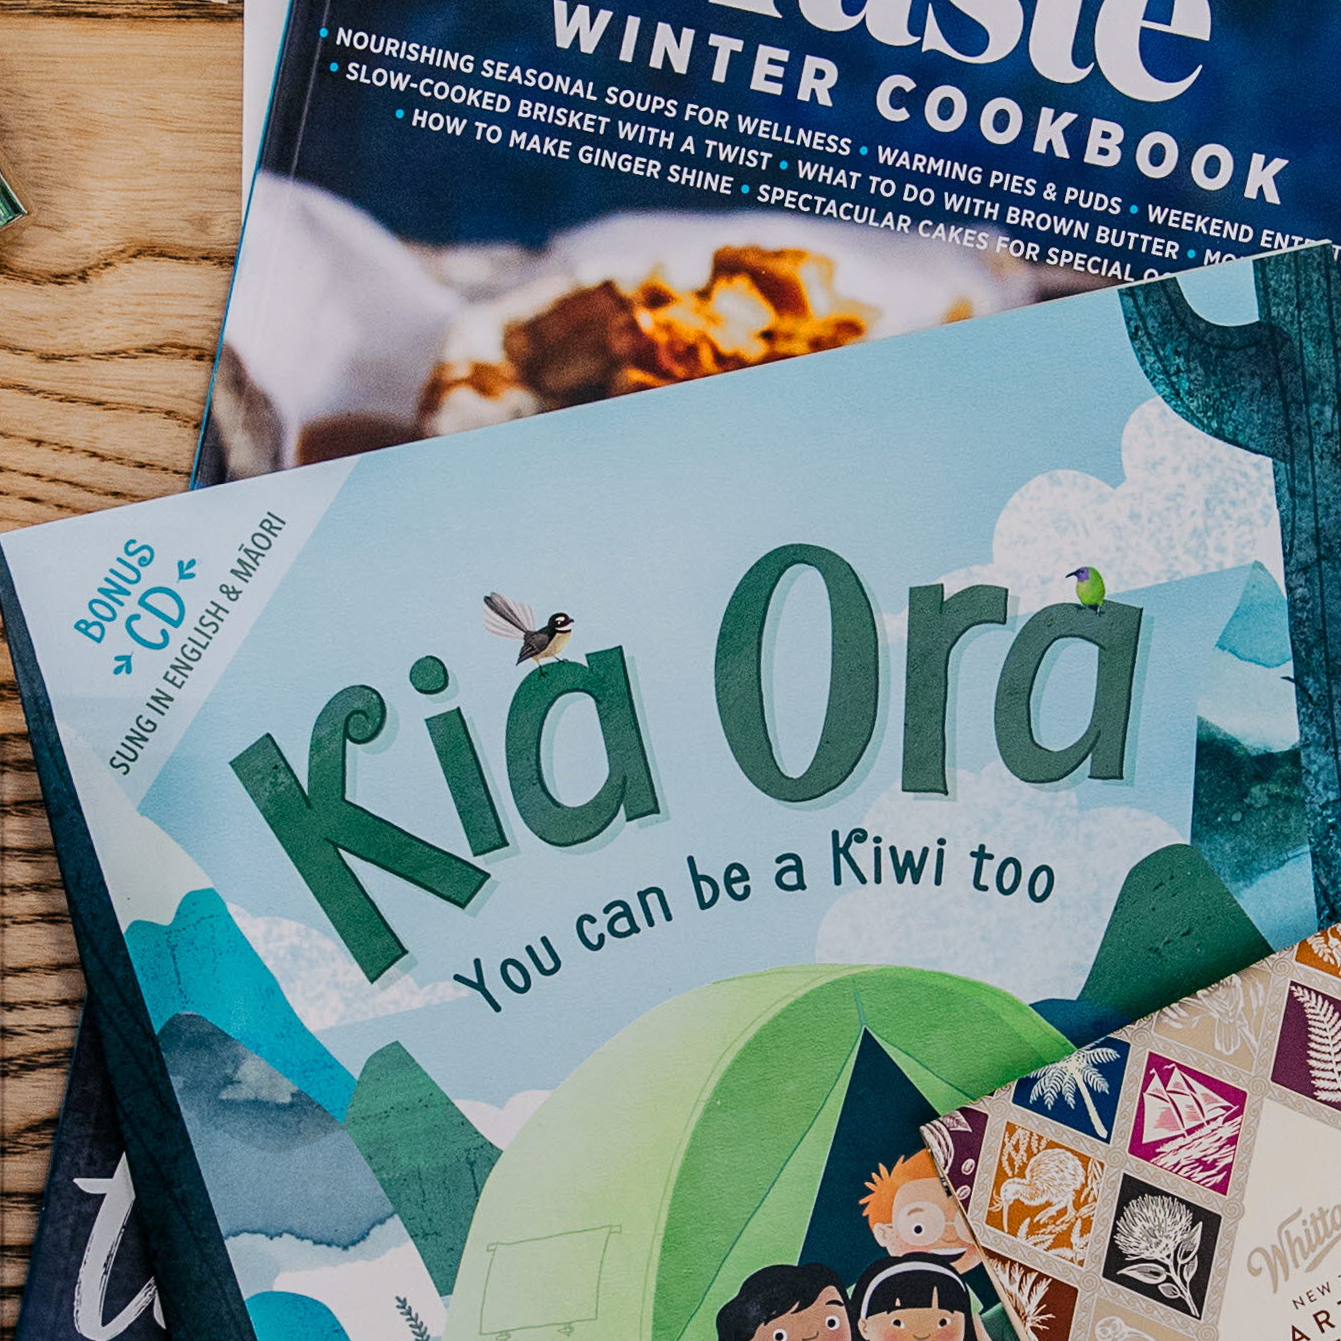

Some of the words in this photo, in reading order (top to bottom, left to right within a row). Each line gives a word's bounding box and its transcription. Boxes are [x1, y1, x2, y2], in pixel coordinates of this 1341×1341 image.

[335, 26, 476, 74] NOURISHING
[481, 59, 598, 102] SEASONAL
[605, 86, 678, 118] SOUPS
[684, 104, 728, 129] FOR
[736, 113, 853, 157] WELLNESS
[876, 144, 983, 185] WARMING
[989, 170, 1037, 198] PIES
[1064, 186, 1122, 216] PUDS
[1147, 204, 1254, 244] WEEKEND
[345, 62, 512, 113] SLOW-COOKED
[517, 99, 611, 135] BRISKET
[617, 120, 674, 148] WITH
[703, 140, 773, 170] TWIST
[797, 159, 859, 189] WHAT
[869, 176, 896, 196] TO
[903, 184, 935, 205] DO
[942, 190, 998, 220] WITH
[1006, 205, 1090, 240] BROWN
[1095, 224, 1180, 260] BUTTER
[411, 106, 467, 137] HOW
[474, 121, 502, 143] TO
[508, 130, 571, 159] MAKE
[578, 143, 661, 179] GINGER
[667, 164, 733, 194] SHINE
[757, 183, 910, 234] SPECTACULAR
[917, 220, 989, 249] CAKES
[995, 236, 1039, 260] FOR
[1045, 246, 1138, 283] SPECIAL
[875, 74, 1290, 205] COOKBOOK
[74, 539, 155, 643] BONUS
[109, 714, 158, 776] SUNG
[146, 687, 175, 716] IN
[162, 600, 230, 690] ENGLISH
[229, 511, 287, 586] MĀORI
[125, 586, 186, 651] CD
[228, 644, 661, 984] Kia
[713, 542, 1144, 805] Ora
[453, 932, 564, 1013] You
[574, 882, 674, 952] can
[687, 854, 751, 912] be
[773, 853, 807, 892] a
[830, 827, 946, 888] Kiwi
[969, 842, 1057, 904] too
[1292, 1281, 1331, 1310] NEW
